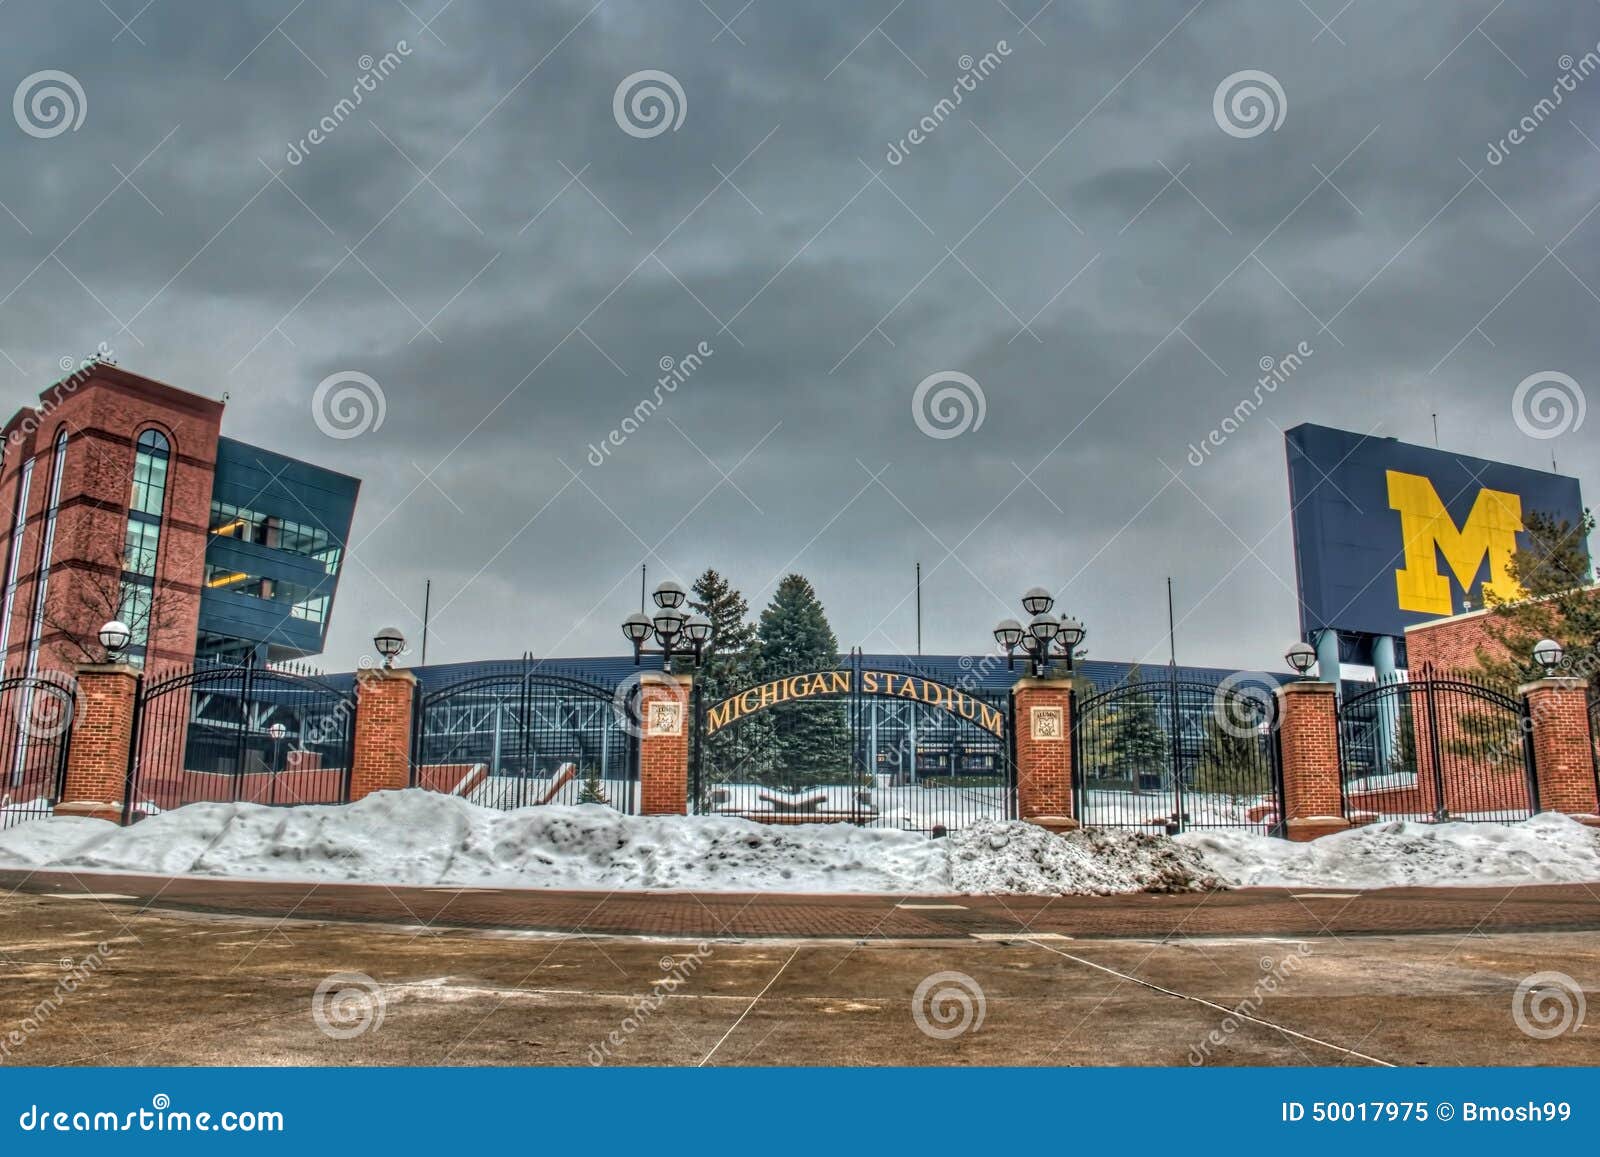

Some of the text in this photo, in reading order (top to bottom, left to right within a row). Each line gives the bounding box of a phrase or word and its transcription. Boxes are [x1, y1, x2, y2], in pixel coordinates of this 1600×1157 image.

[1386, 469, 1525, 616] M
[707, 671, 1004, 738] MICHIGAN STADIUM
